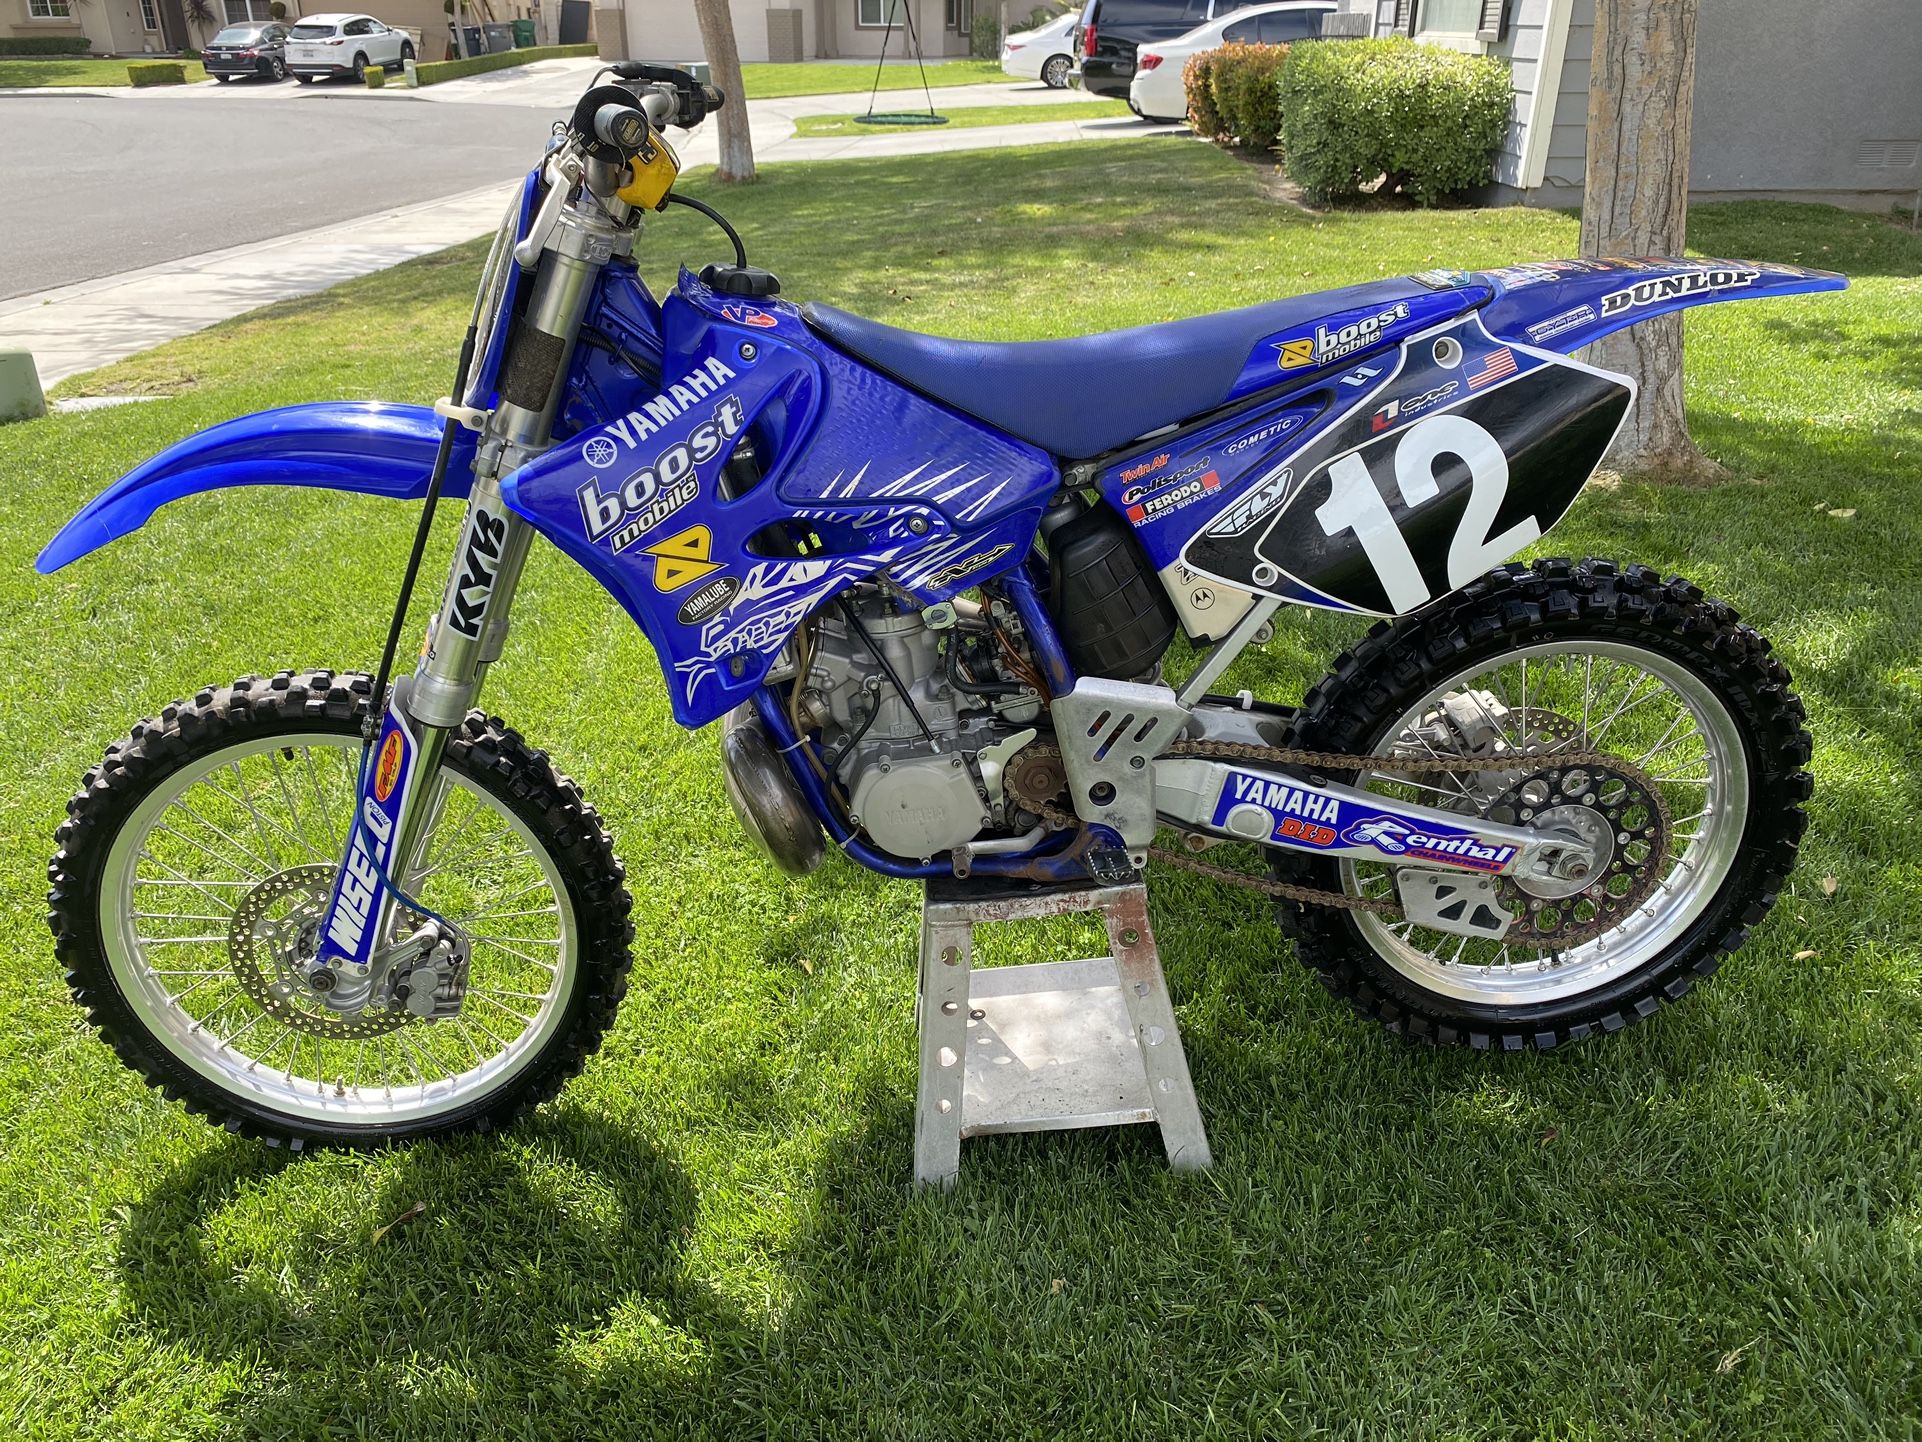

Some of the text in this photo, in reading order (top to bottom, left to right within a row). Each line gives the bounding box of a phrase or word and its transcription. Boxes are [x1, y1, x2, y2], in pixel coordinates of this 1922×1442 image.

[1604, 270, 1758, 314] DUNLOP
[1316, 303, 1409, 356] boost
[1321, 330, 1382, 365] mobile
[604, 356, 736, 450] YAMAHA
[1228, 419, 1292, 453] COMETIC
[578, 396, 743, 542] boost
[1126, 456, 1210, 501] Polisport
[612, 476, 698, 554] mobile
[1133, 484, 1222, 528] RACING BRAKES
[1145, 481, 1201, 514] FERODO
[1212, 472, 1289, 532] FLY
[1314, 414, 1542, 615] 12
[449, 509, 505, 638] KYB
[684, 579, 730, 616] YAMALUBE
[692, 590, 733, 620] FACTORY RACING
[367, 800, 391, 826] PISTON
[1235, 774, 1340, 825] YAMAHA
[1350, 820, 1515, 862] Renthal
